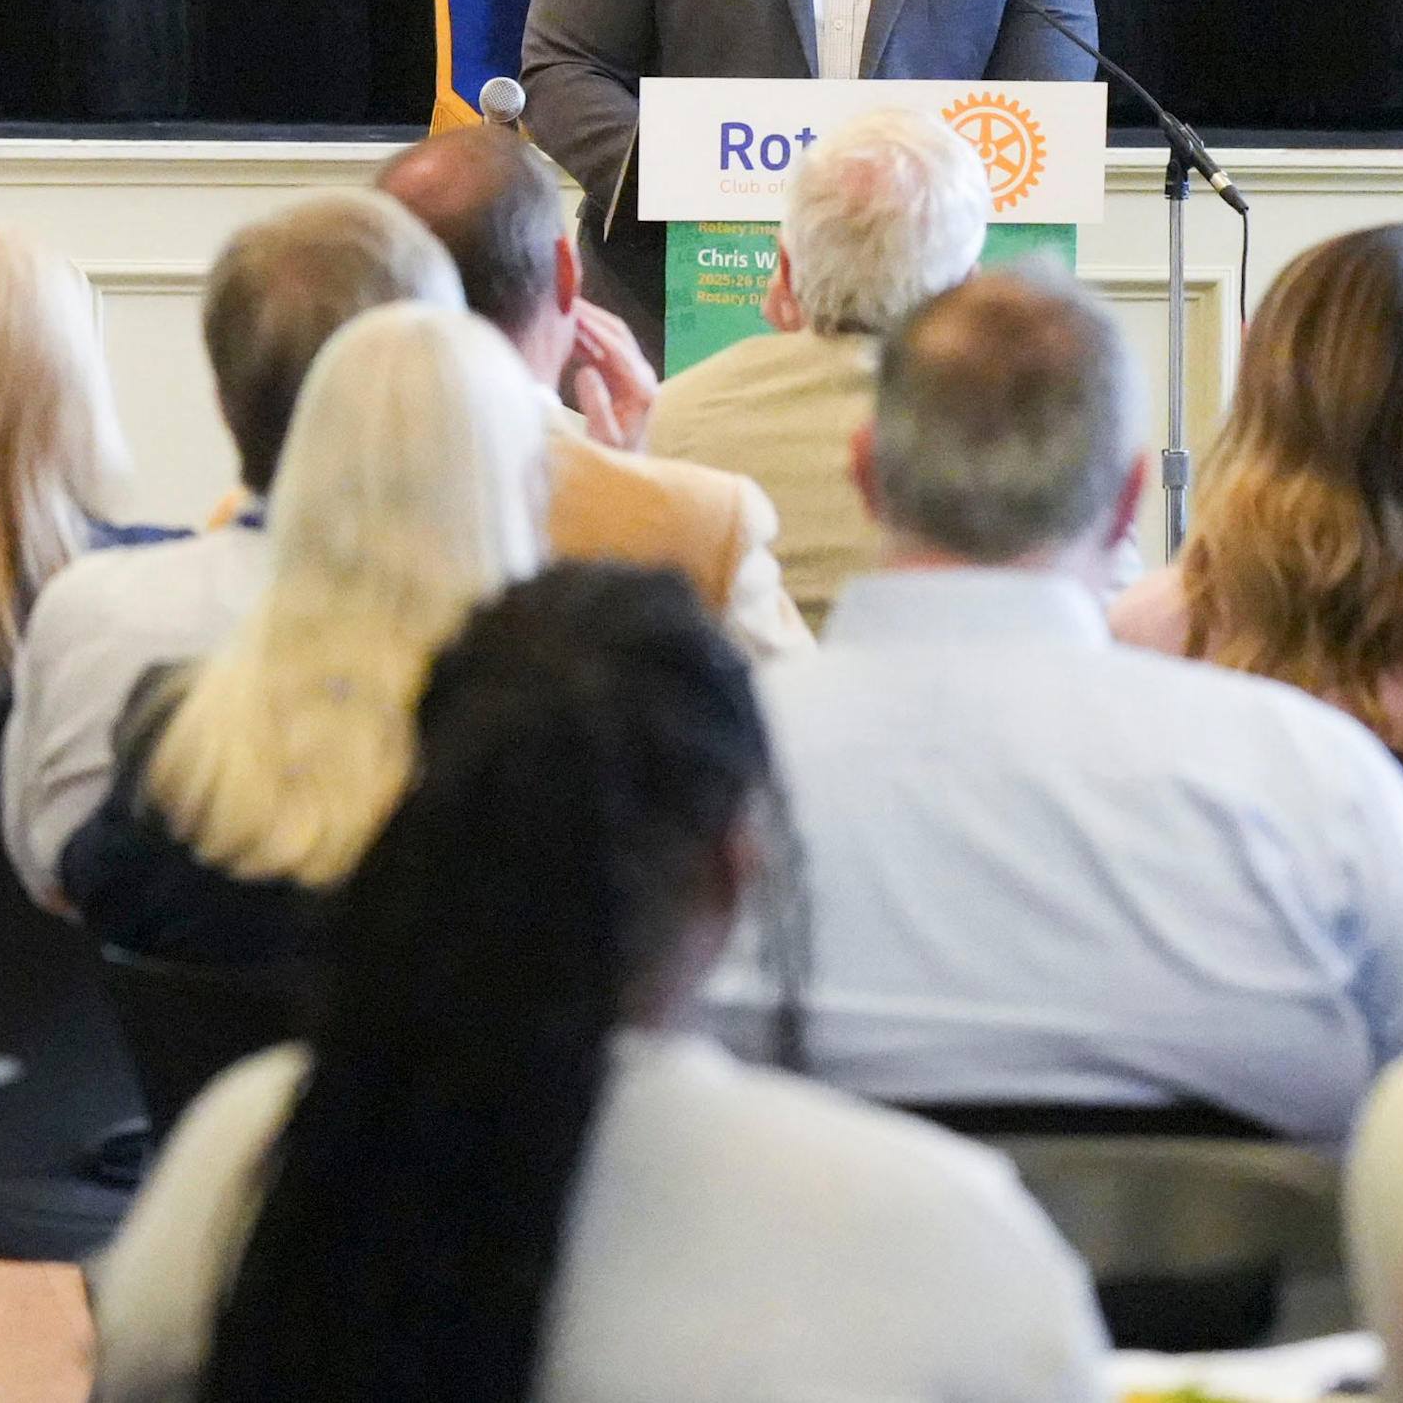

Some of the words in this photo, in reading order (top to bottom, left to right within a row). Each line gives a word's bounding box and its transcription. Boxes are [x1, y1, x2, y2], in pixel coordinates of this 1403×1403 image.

[720, 179, 760, 194] Club
[768, 178, 786, 194] of
[697, 248, 749, 268] Chris
